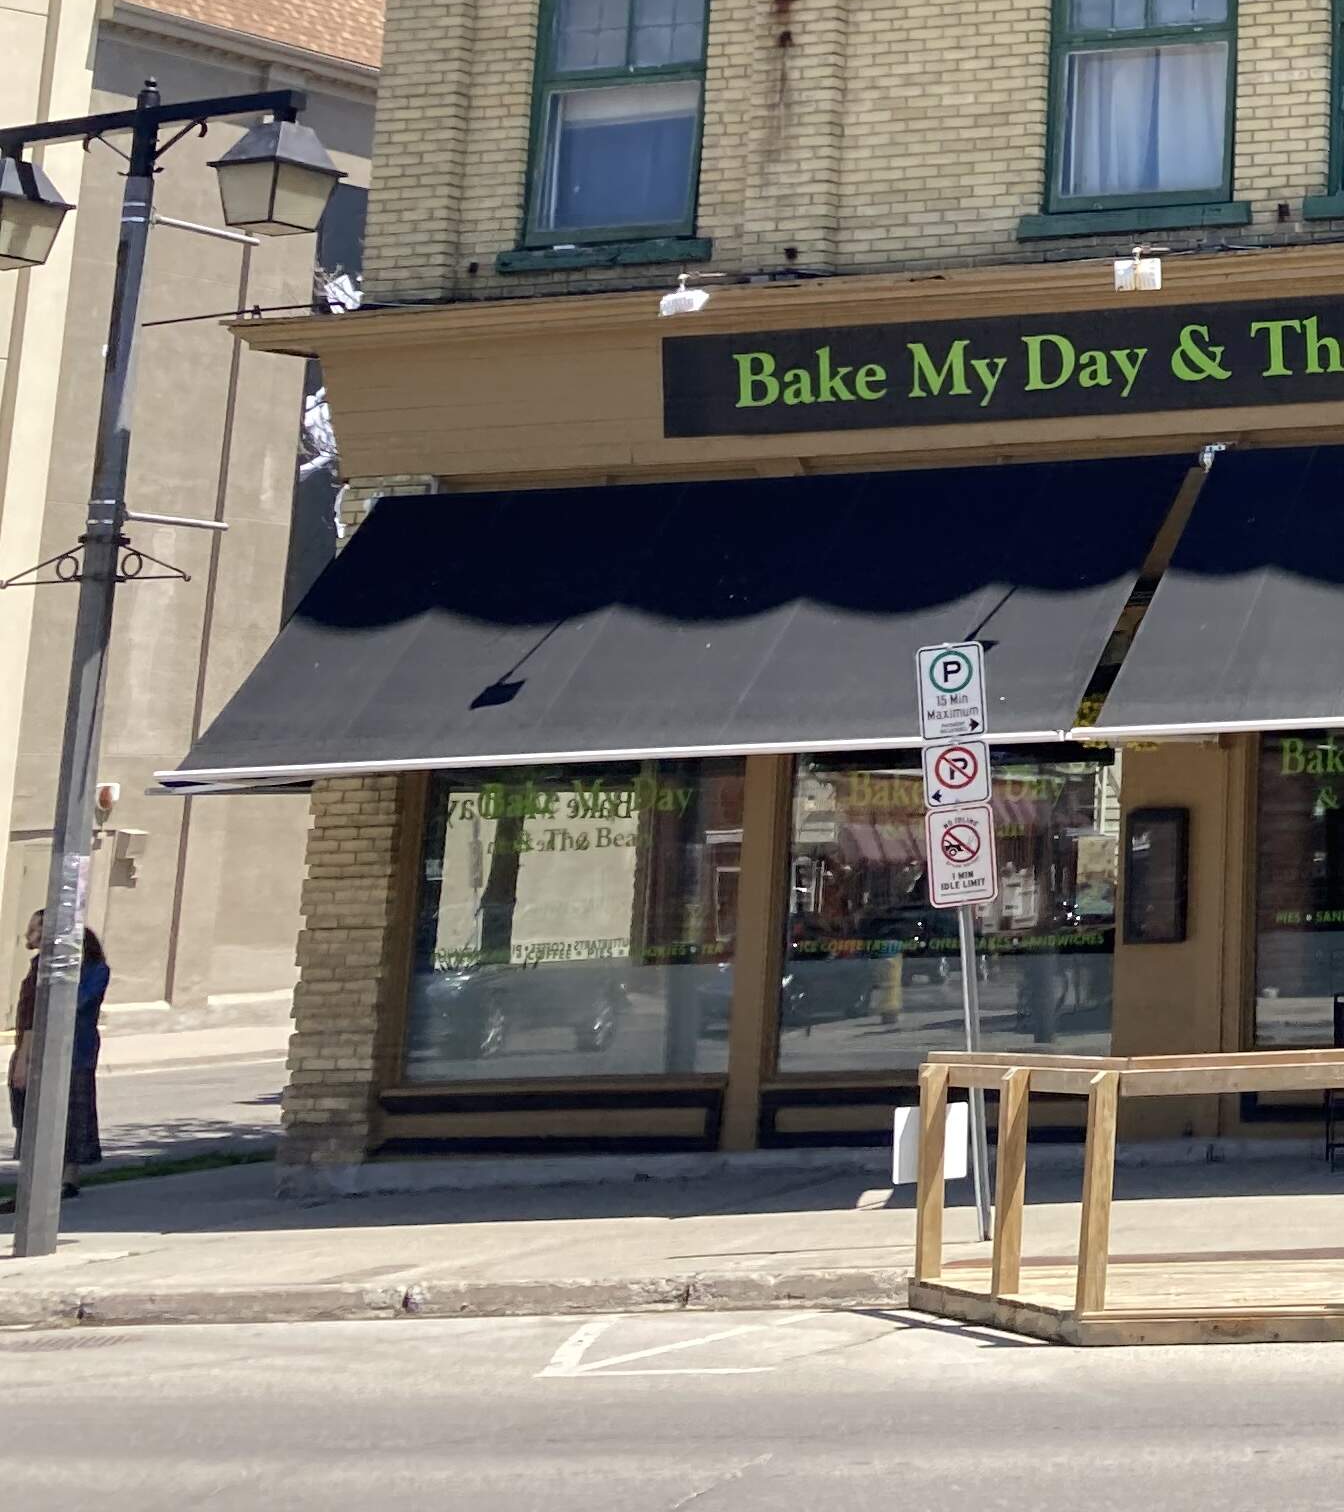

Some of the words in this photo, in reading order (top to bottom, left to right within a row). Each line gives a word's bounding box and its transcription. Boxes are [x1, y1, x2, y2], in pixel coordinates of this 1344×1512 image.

[734, 345, 887, 409] Bake
[908, 340, 1007, 406] My
[1022, 332, 1147, 398] Day
[1170, 324, 1231, 382] &
[943, 660, 962, 683] P
[936, 695, 947, 706] 15
[927, 707, 979, 720] Maximum
[958, 870, 974, 880] MIN
[940, 880, 960, 890] IDLE
[963, 878, 986, 889] LIMIT
